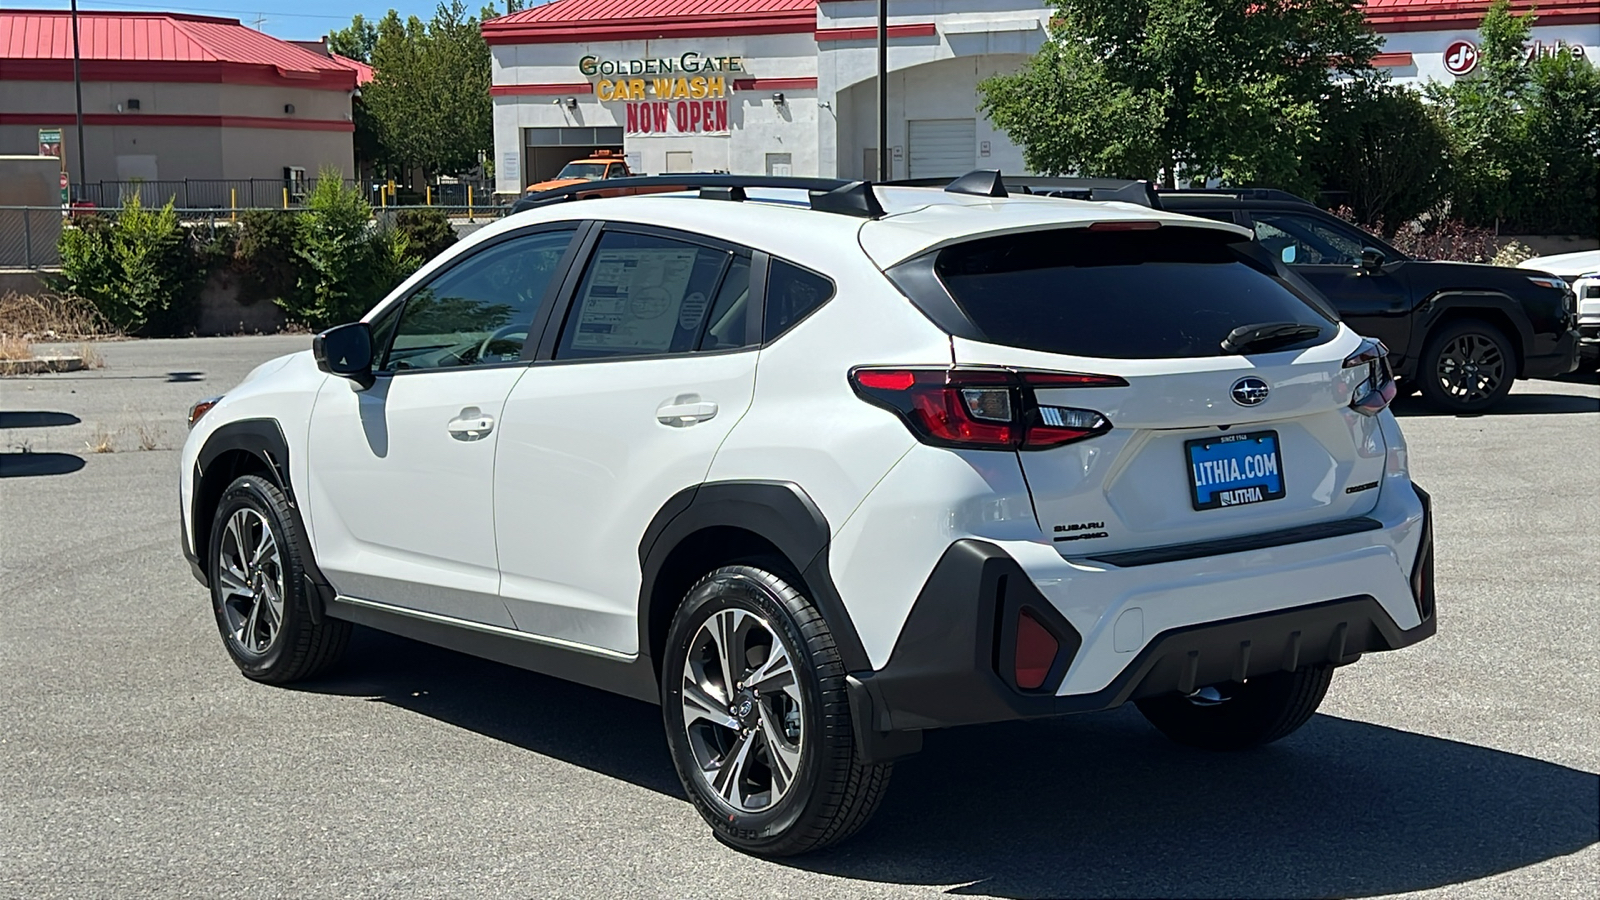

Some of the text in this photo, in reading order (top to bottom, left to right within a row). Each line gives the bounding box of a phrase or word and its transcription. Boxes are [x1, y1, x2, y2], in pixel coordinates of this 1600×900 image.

[579, 52, 742, 76] GOLDEN GATE
[597, 76, 725, 101] CAR WASH
[627, 101, 727, 133] NOW OPEN
[1220, 435, 1235, 443] SINCE
[1193, 452, 1278, 487] LITHIA.COM
[1230, 487, 1263, 505] LITHIA
[1053, 521, 1104, 532] SUBARU
